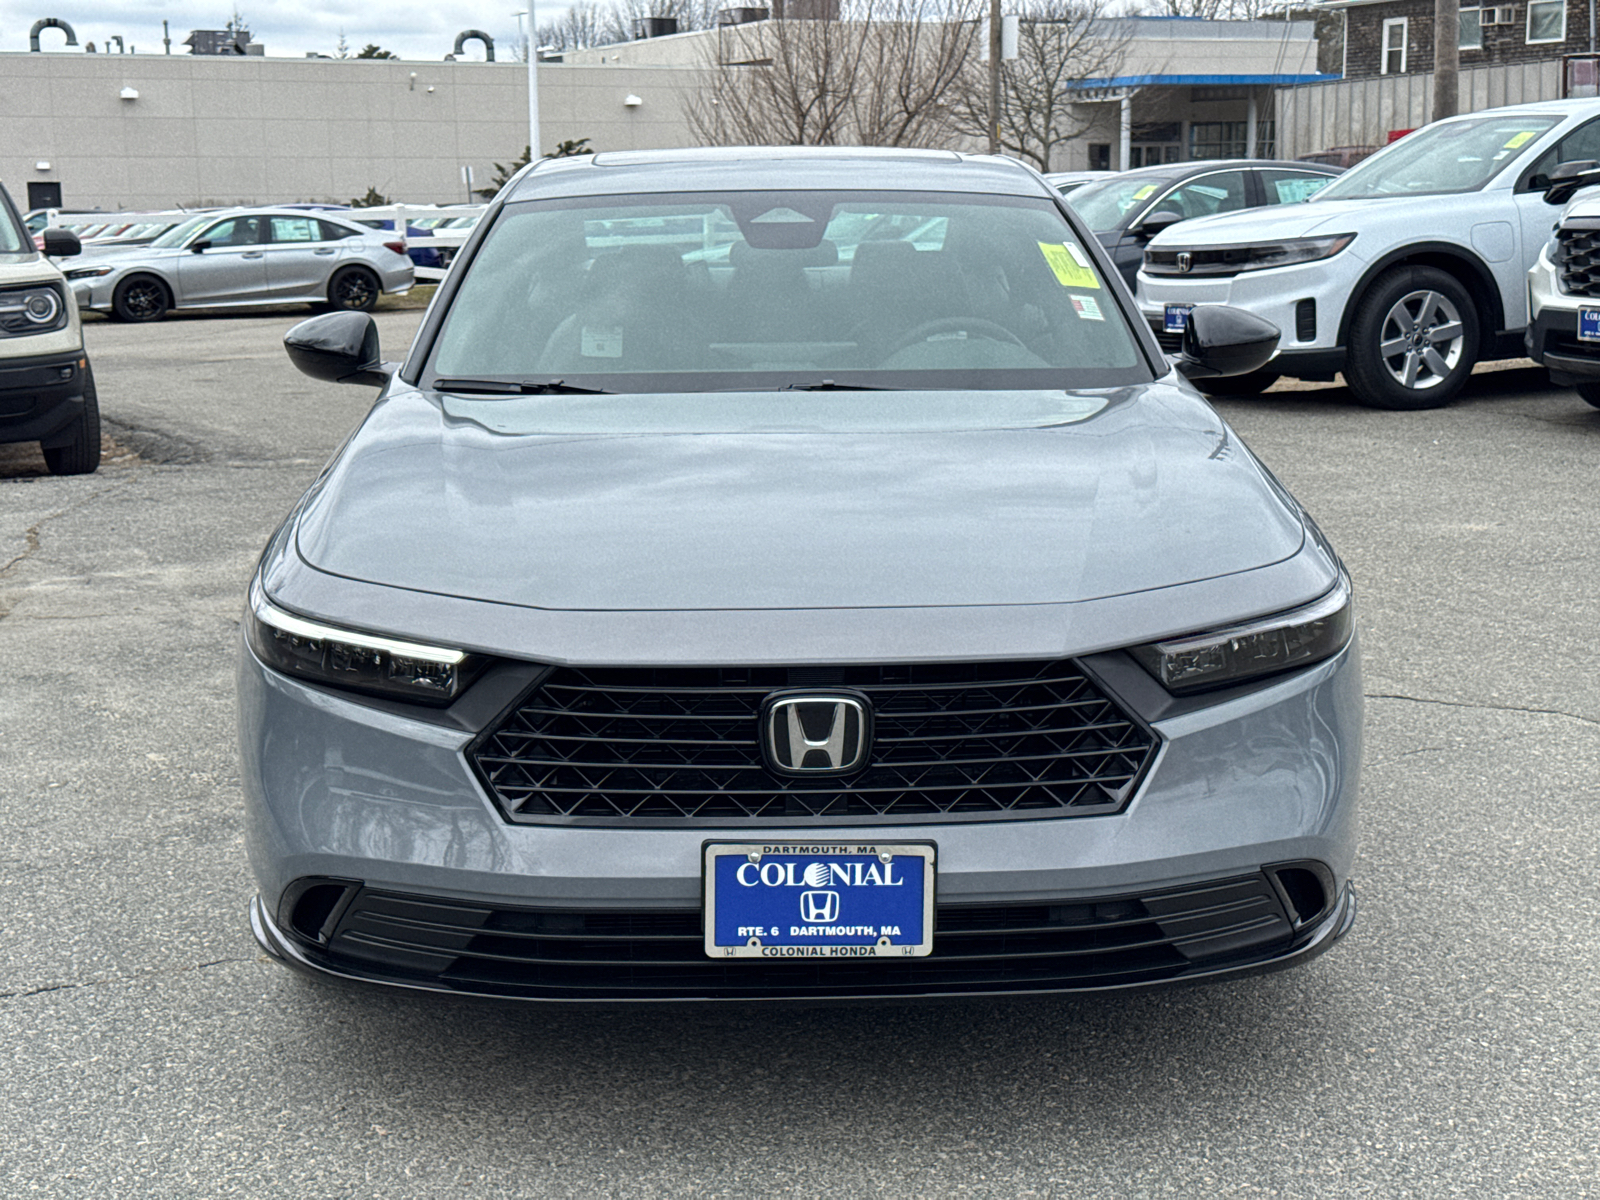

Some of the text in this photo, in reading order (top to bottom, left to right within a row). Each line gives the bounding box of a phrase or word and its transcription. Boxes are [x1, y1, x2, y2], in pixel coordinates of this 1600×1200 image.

[763, 846, 877, 855] DARTMOUTH, MA
[736, 862, 904, 888] COLONIAL
[738, 926, 901, 938] RTE. 6 DARTMOUTH, MA
[761, 946, 877, 956] COLONIAL HONDA
